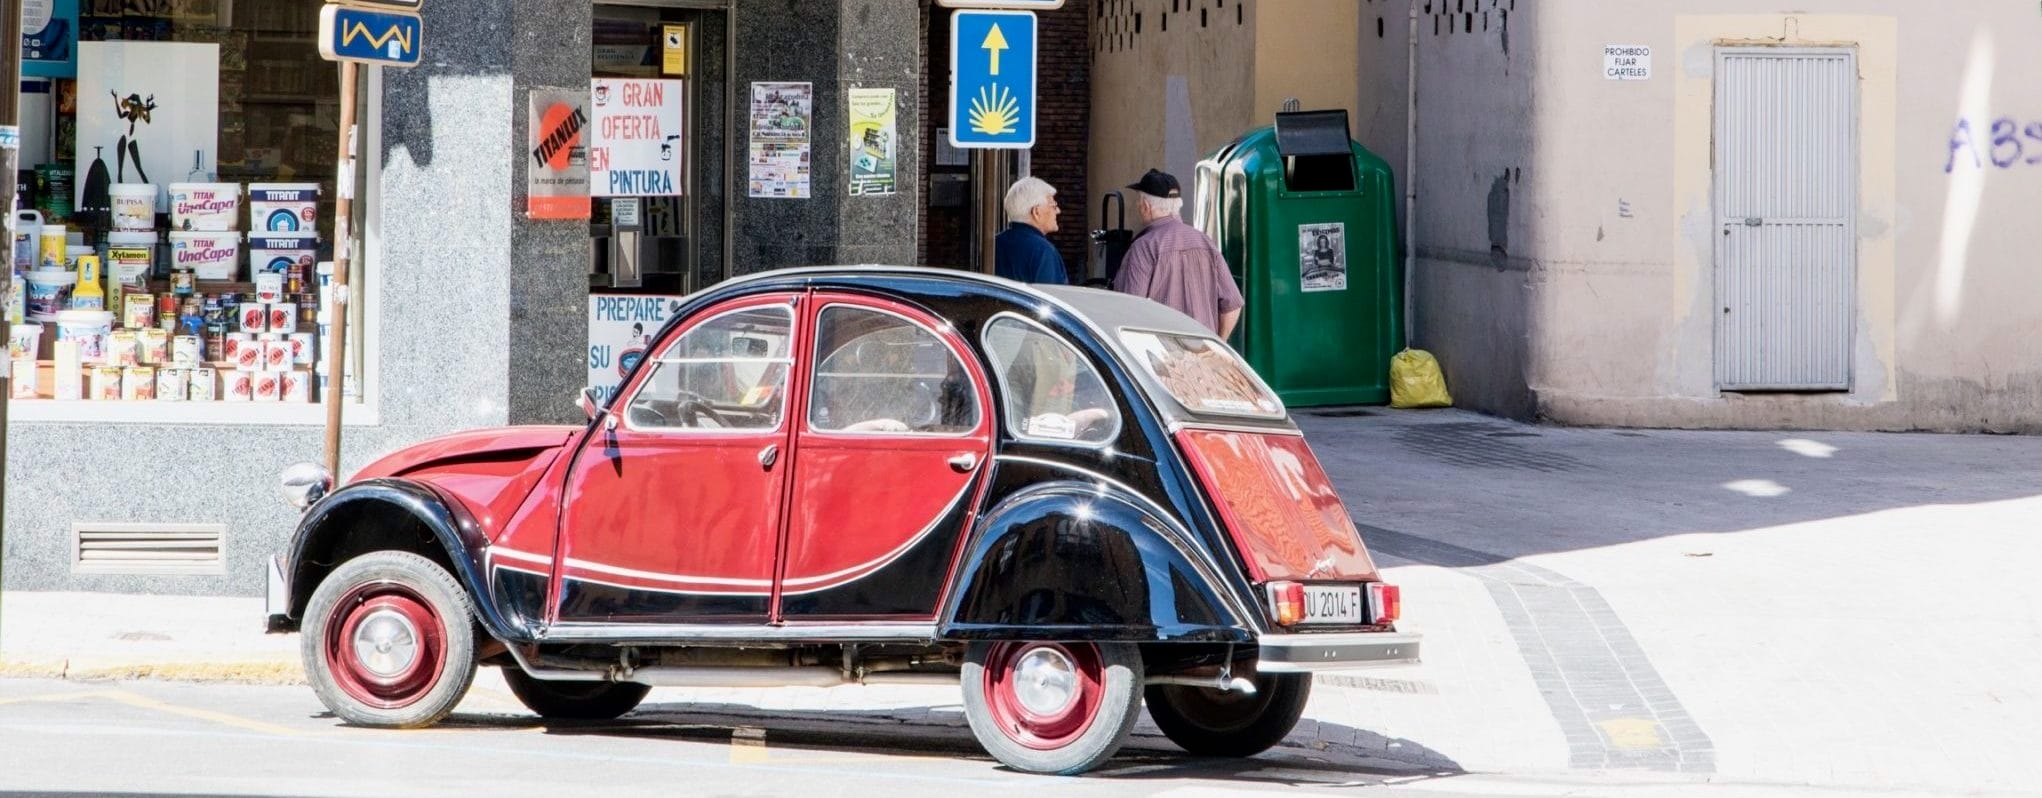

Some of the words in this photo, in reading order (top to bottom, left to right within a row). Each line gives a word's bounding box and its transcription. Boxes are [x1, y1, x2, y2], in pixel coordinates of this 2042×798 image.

[1605, 48, 1649, 56] PROHIBIDO
[1615, 58, 1637, 66] FIJAR
[1607, 68, 1647, 77] CARTELES
[623, 83, 663, 107] GRAN
[602, 115, 661, 140] OFERTA
[533, 105, 588, 169] TITANLUX
[591, 147, 609, 172] EN
[610, 170, 673, 195] PINTURA
[193, 192, 215, 200] TITAN
[266, 191, 299, 201] TITANIT
[177, 199, 235, 215] UnaCapa
[193, 240, 215, 248] TITAN
[266, 239, 299, 249] TITANIT
[111, 250, 148, 261] Xylamon
[177, 248, 235, 264] UnaCapa
[597, 297, 666, 321] PREPARE
[590, 345, 611, 369] SU
[1320, 592, 1347, 617] 2014
[1351, 592, 1357, 617] F
